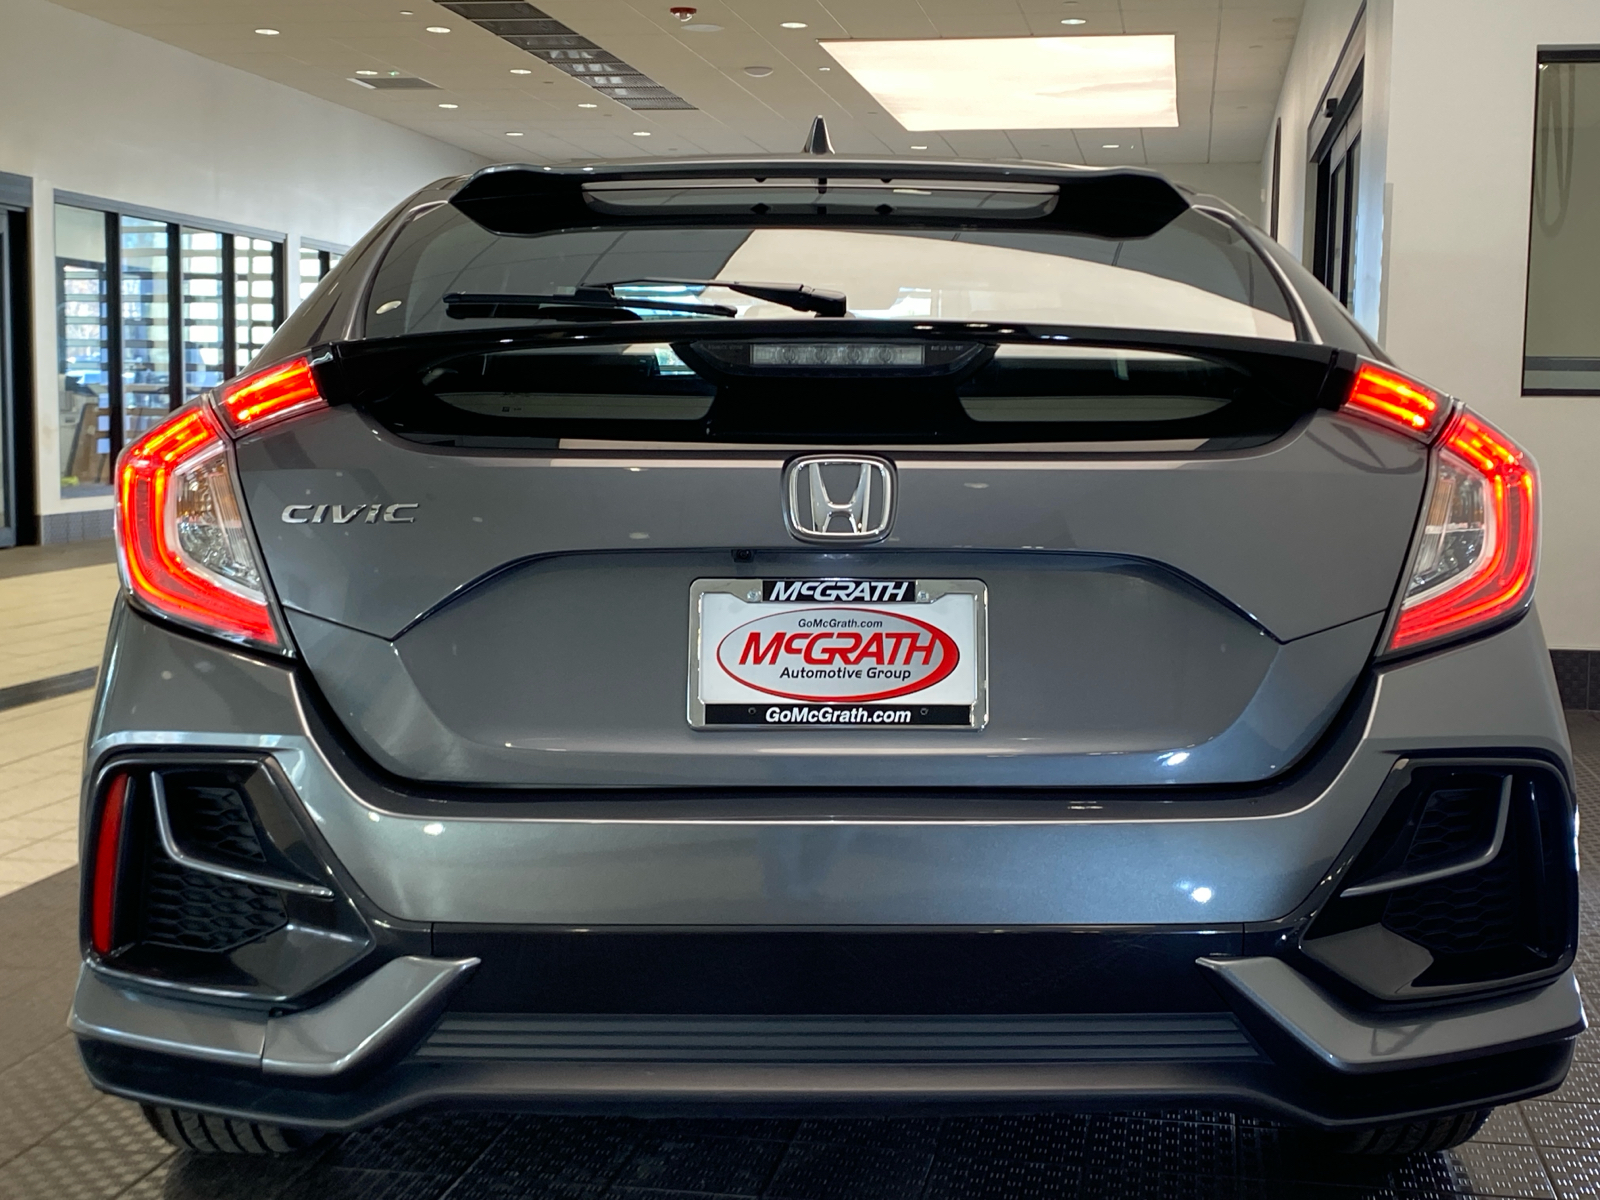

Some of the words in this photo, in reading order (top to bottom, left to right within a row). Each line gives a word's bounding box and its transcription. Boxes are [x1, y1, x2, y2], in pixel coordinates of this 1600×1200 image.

[281, 503, 419, 524] CIVIC
[798, 618, 883, 629] GoMcGrath.com
[780, 667, 862, 679] Automotive
[866, 668, 911, 682] Group
[765, 707, 911, 724] GoMcGrath.com
